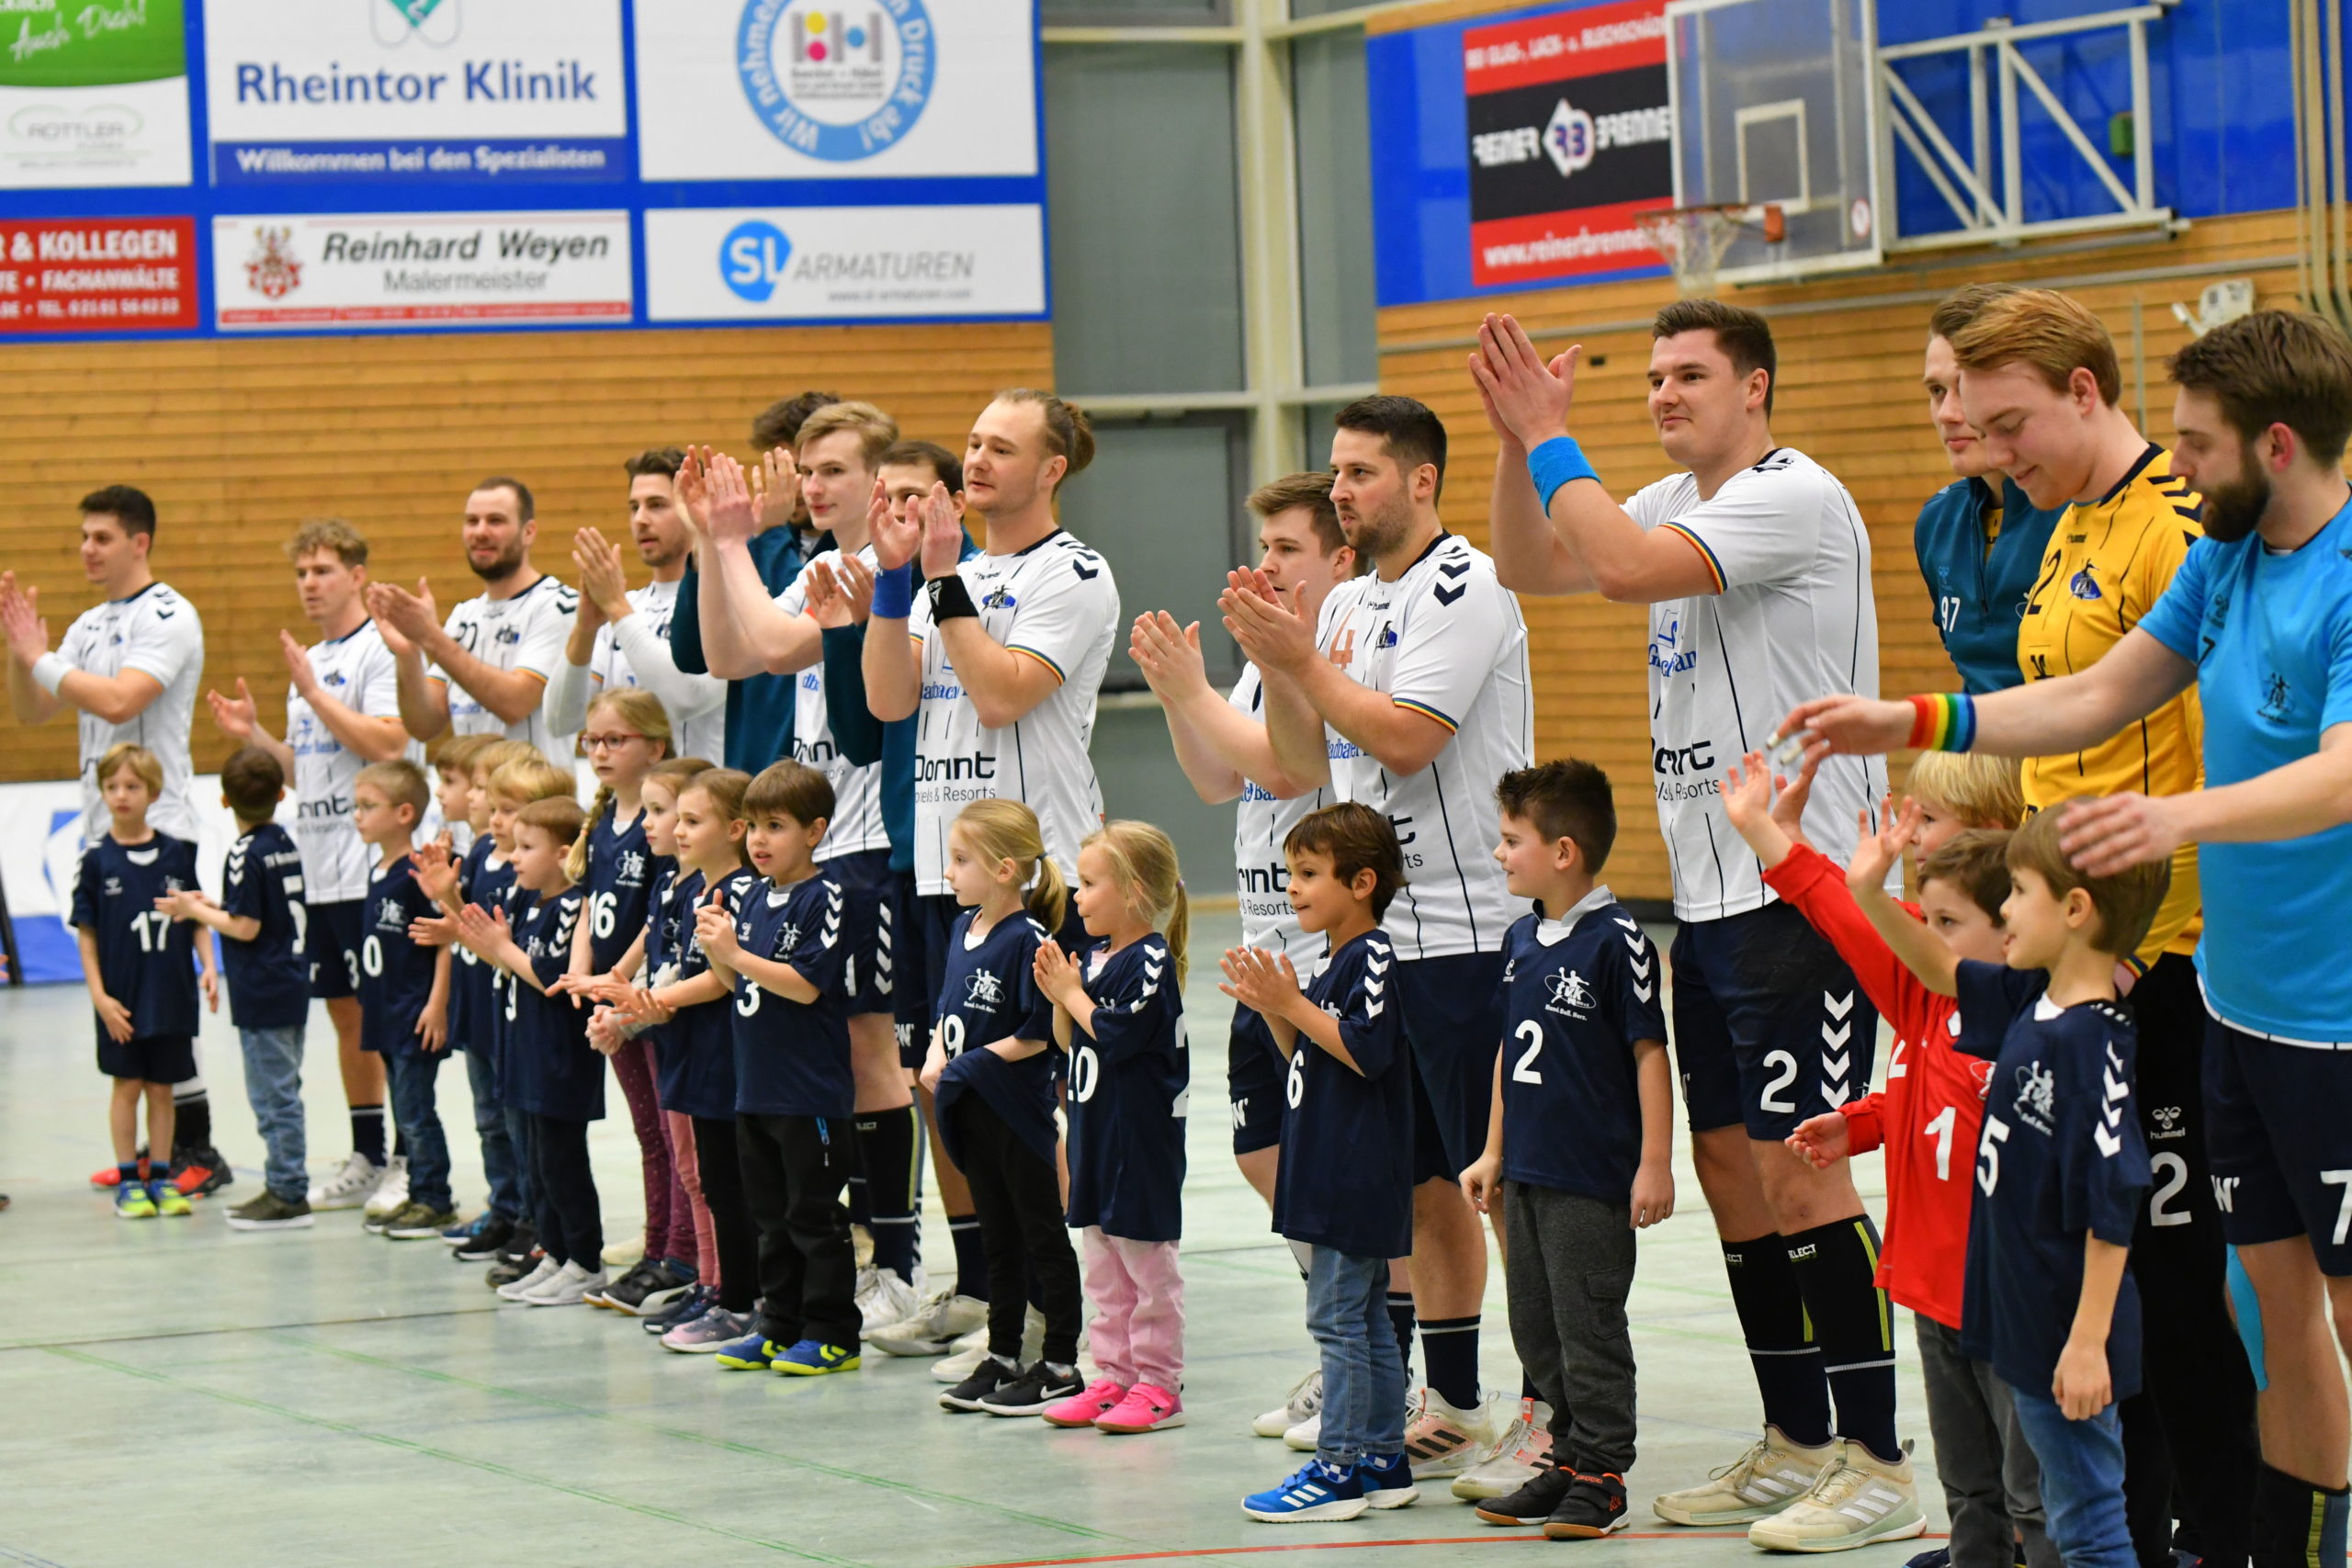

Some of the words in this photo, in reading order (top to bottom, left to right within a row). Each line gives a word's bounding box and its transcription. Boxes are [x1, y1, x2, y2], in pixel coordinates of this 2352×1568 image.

[236, 62, 447, 105] Rheintor
[464, 62, 597, 103] Klinik
[893, 18, 927, 107] Druck
[772, 107, 820, 152] Wir
[857, 104, 902, 151] ab!
[236, 149, 386, 173] Willkommen
[390, 148, 424, 172] bei
[430, 147, 469, 170] den
[474, 145, 605, 175] Spezialisten
[10, 231, 34, 262] &
[39, 229, 177, 262] KOLLEGEN
[322, 230, 480, 264] Reinhard
[498, 231, 610, 265] Weyen
[730, 236, 779, 284] SL
[793, 252, 974, 281] ARMATUREN
[41, 265, 179, 293] FACHANWÄLTE
[384, 269, 548, 293] Malermeister
[1941, 596, 1960, 632] 97
[943, 785, 995, 802] Resorts
[130, 911, 171, 952] 17
[737, 972, 760, 1017] 3
[1512, 1020, 1543, 1084] 2
[1287, 1049, 1305, 1110] 6
[1760, 1050, 1798, 1113] 2
[1924, 1106, 1956, 1181] 1
[2150, 1127, 2186, 1139] hummel
[1976, 1114, 2010, 1198] 5
[2150, 1151, 2192, 1226] 2
[2320, 1169, 2352, 1245] 7
